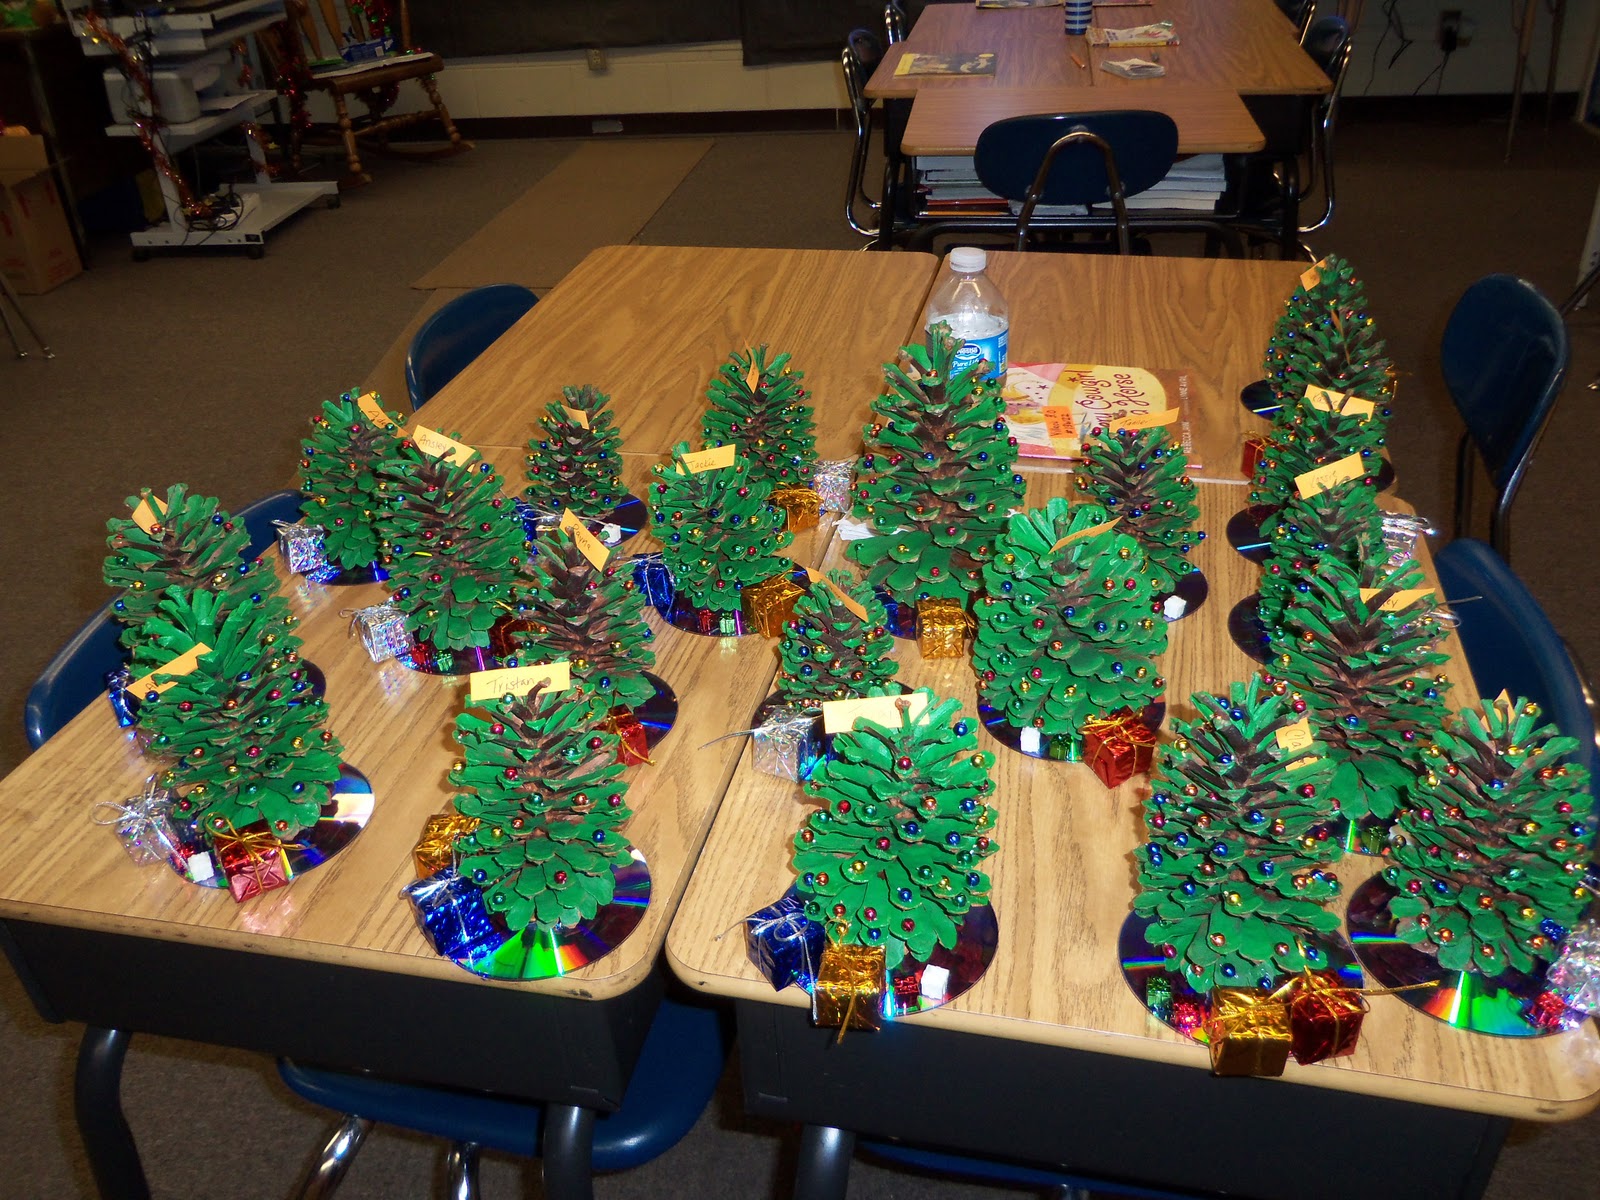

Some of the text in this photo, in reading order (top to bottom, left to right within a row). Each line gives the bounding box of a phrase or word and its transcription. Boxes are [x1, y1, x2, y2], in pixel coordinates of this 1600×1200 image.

[952, 360, 968, 368] Pure
[1065, 370, 1112, 410] Cowgirl
[1113, 373, 1150, 407] Horse
[417, 433, 448, 451] Ansley
[685, 457, 717, 470] Jackie
[486, 675, 536, 694] Tristan
